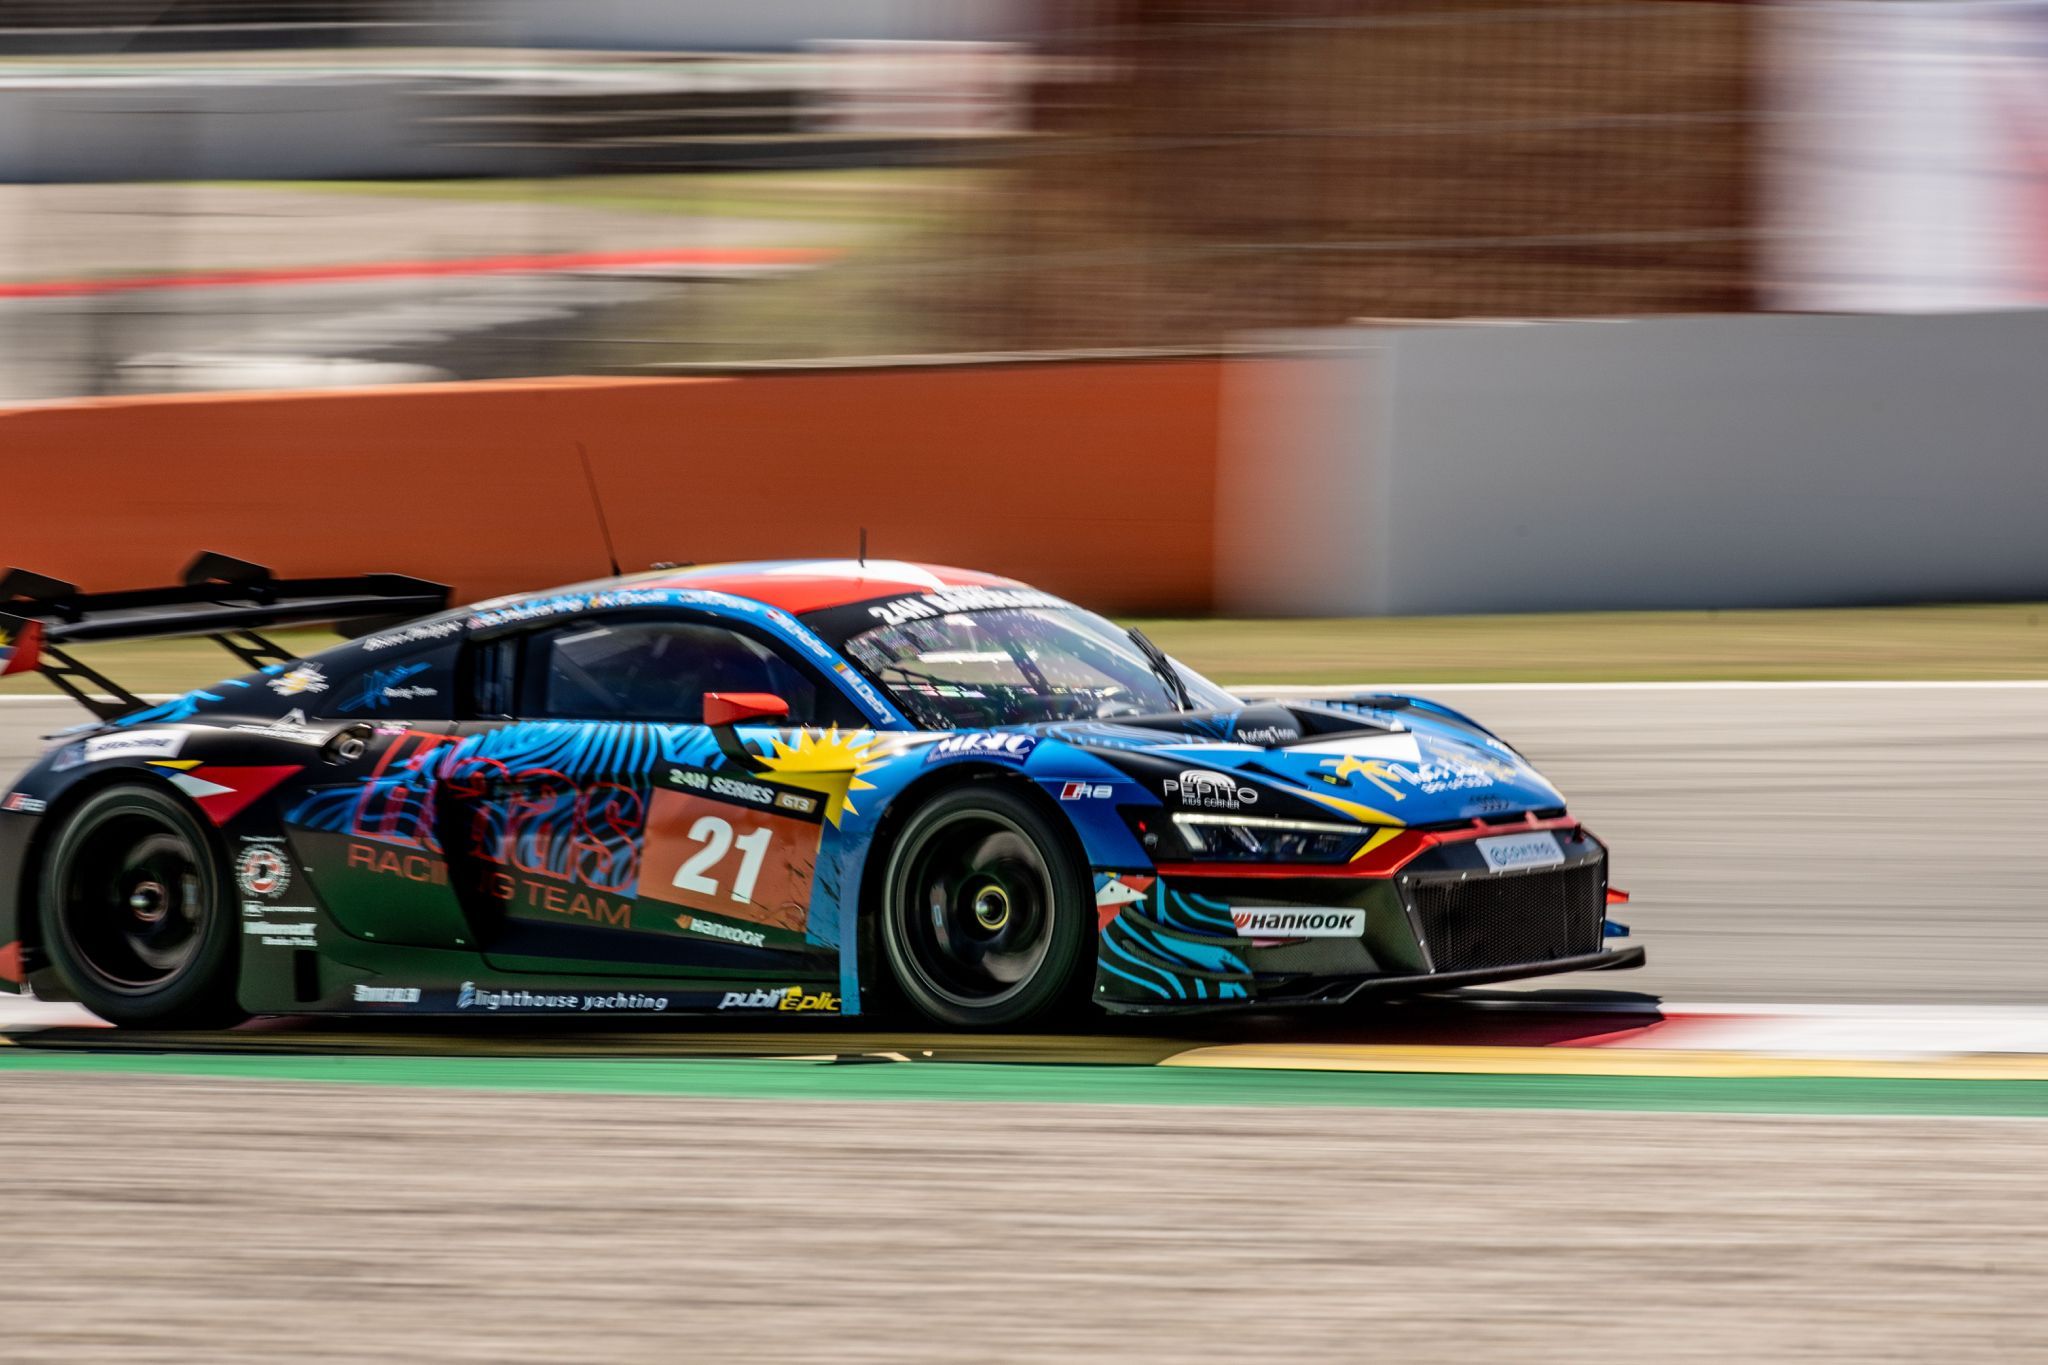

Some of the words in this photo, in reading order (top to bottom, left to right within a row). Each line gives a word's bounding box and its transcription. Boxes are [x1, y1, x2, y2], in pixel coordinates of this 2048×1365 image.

[669, 768, 709, 790] 24H
[710, 776, 775, 804] SERIES
[782, 794, 810, 811] GT3
[1163, 774, 1258, 804] PEPITO
[672, 816, 774, 904] 21
[522, 879, 631, 929] TEAM
[475, 990, 579, 1010] lighthouse
[581, 992, 668, 1011] yachting
